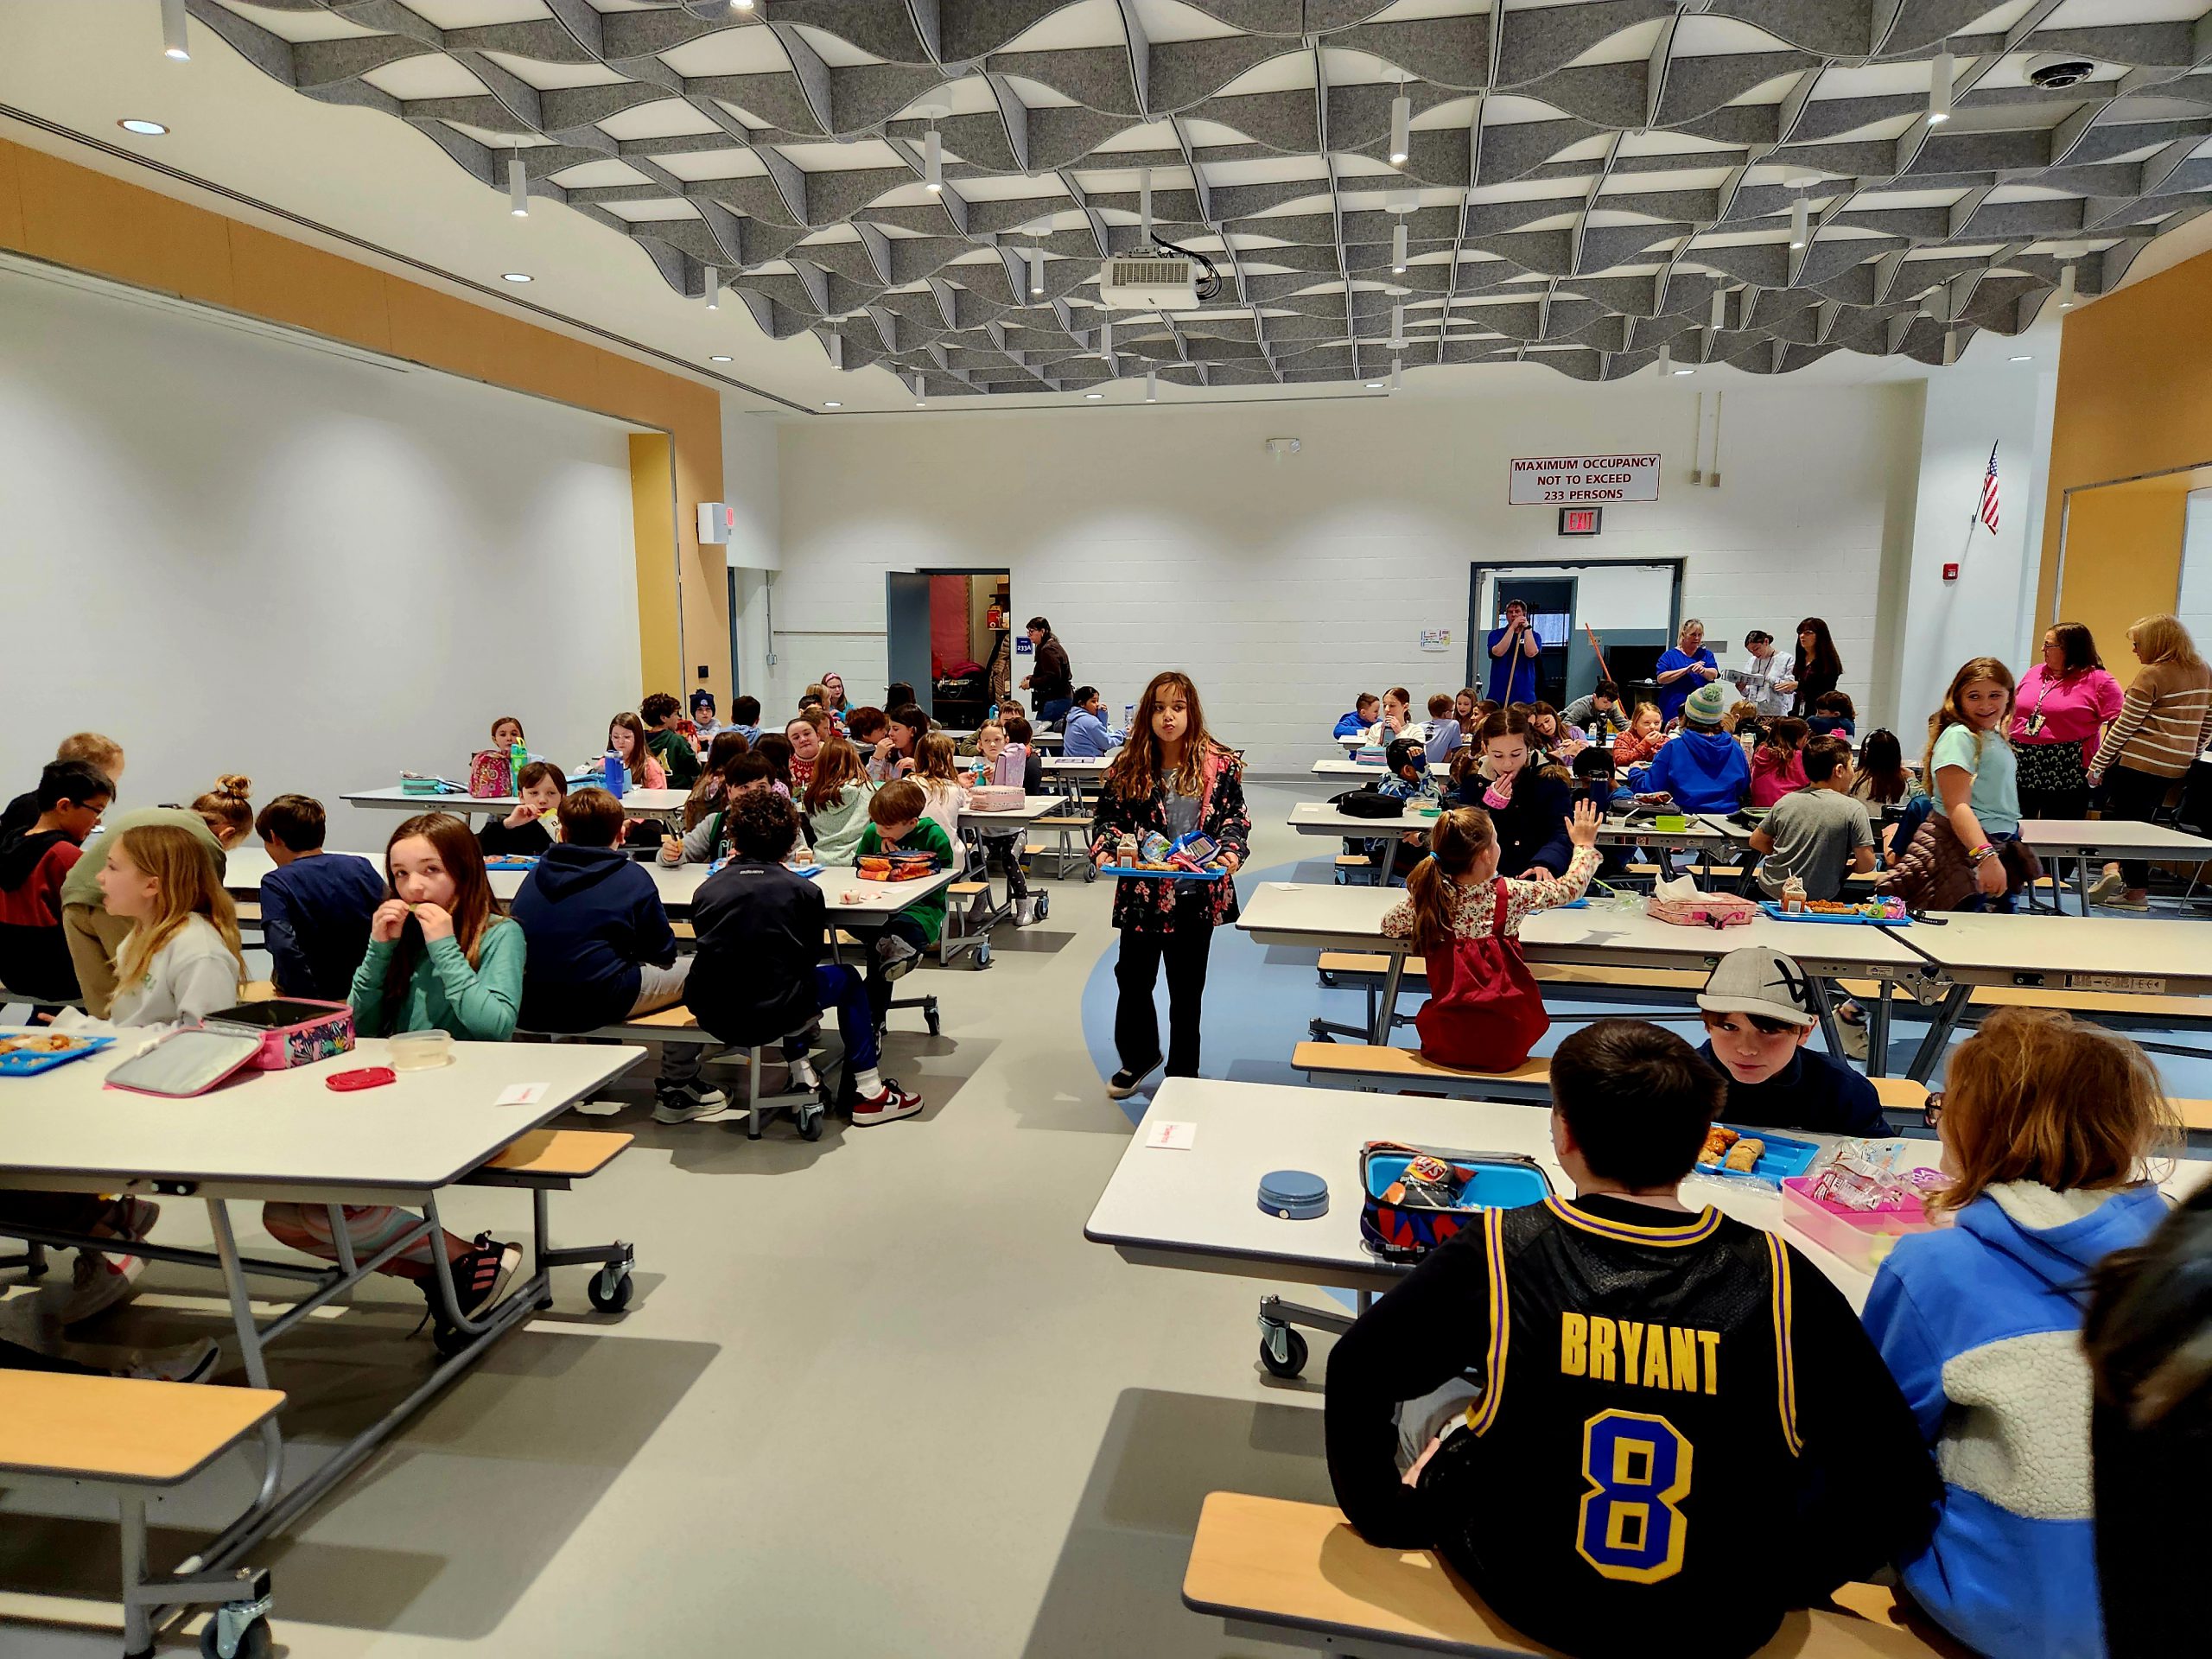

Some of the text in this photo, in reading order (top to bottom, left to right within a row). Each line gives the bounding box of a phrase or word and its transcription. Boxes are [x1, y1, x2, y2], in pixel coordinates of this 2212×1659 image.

[1515, 457, 1656, 471] MAXIMUM OCCUPANCY
[1537, 474, 1631, 486] NOT TO EXCEED
[1544, 489, 1624, 500] 233 PERSONS
[1568, 511, 1594, 531] EXIT
[1560, 1311, 1720, 1395] BRYANT
[1575, 1408, 1694, 1585] 8
